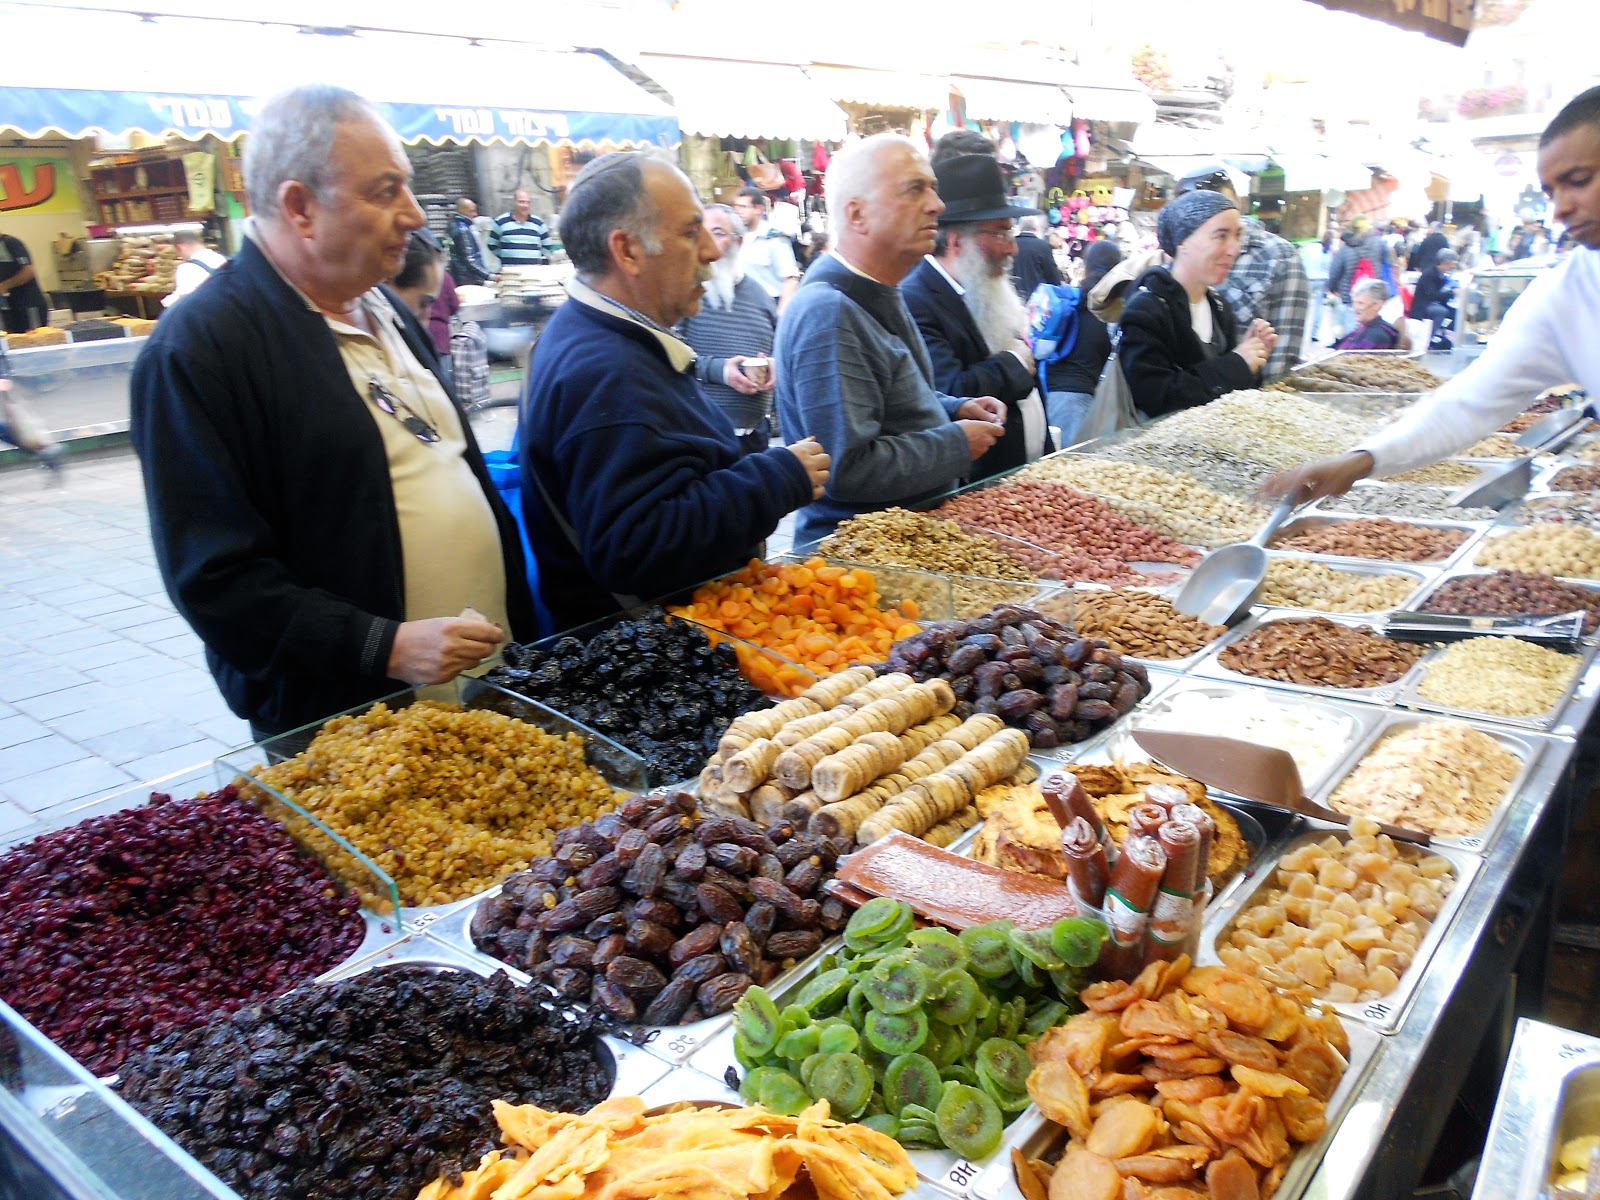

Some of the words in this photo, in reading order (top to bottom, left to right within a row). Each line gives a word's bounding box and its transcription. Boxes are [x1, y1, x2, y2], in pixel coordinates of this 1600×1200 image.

[1364, 1003, 1391, 1020] 48
[668, 1034, 697, 1054] 28
[950, 1162, 977, 1186] 48
